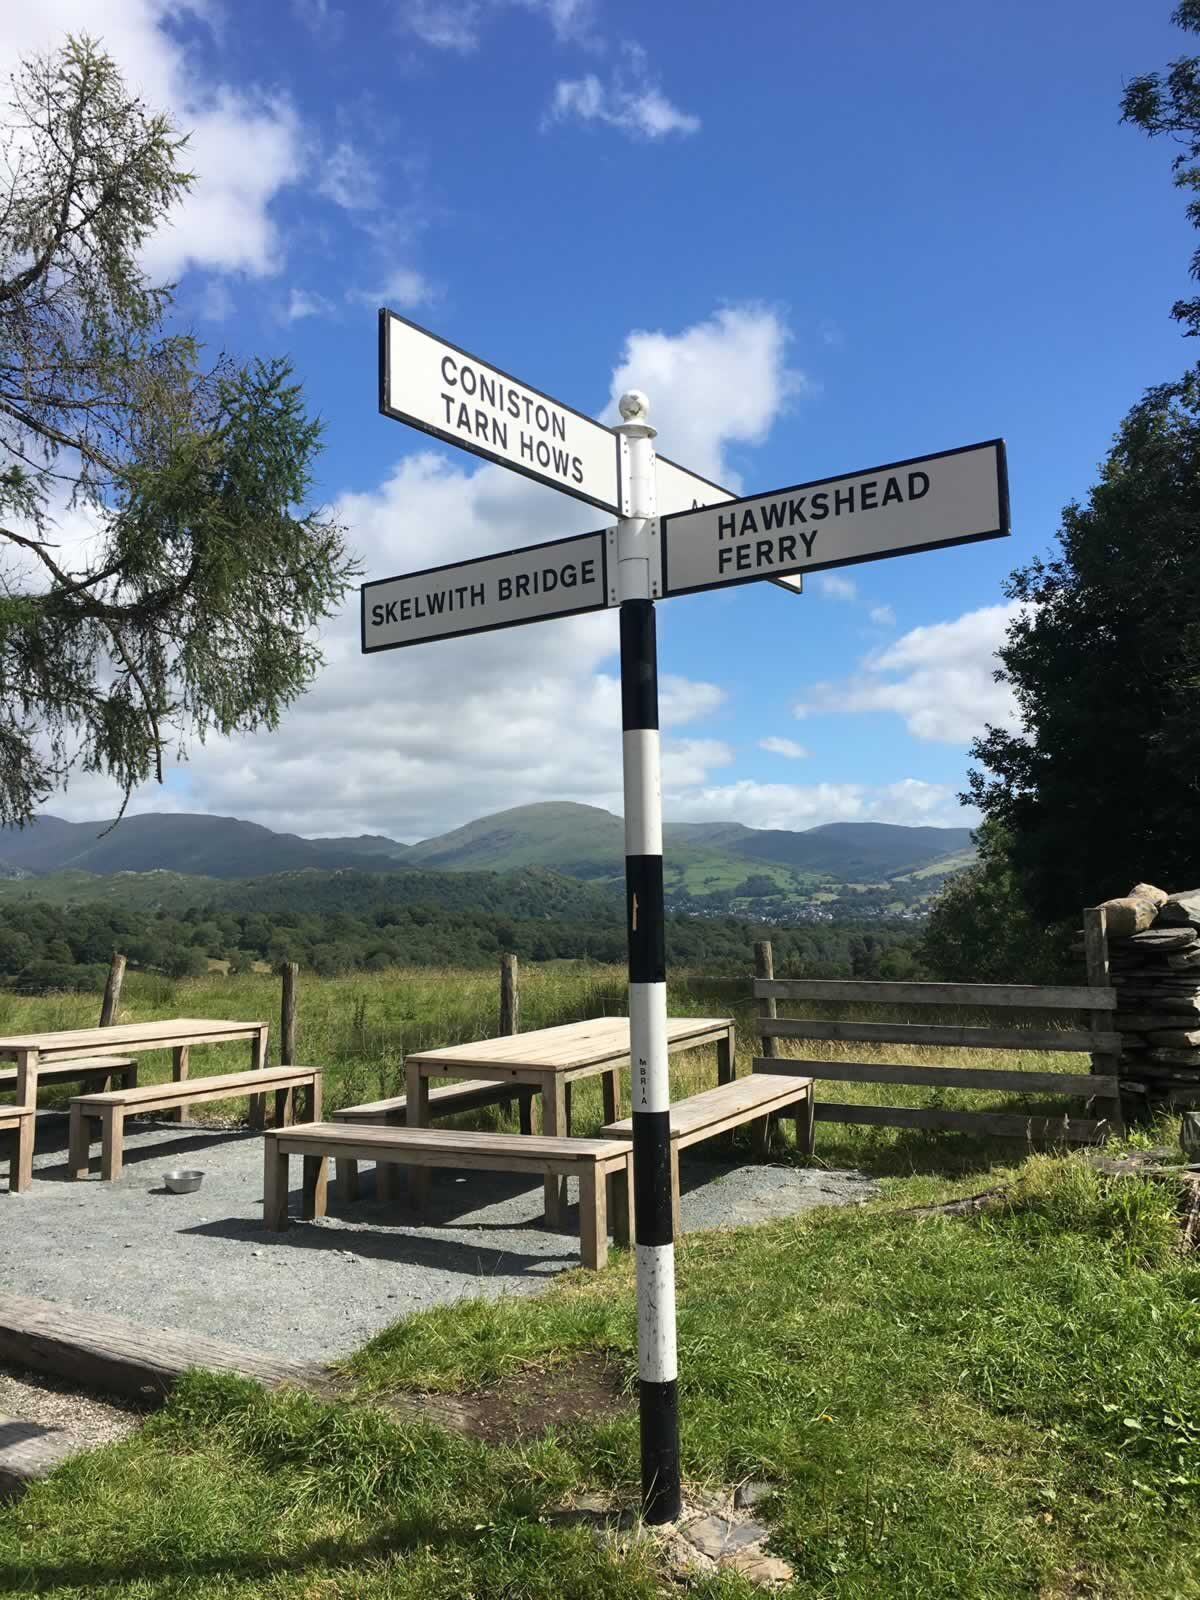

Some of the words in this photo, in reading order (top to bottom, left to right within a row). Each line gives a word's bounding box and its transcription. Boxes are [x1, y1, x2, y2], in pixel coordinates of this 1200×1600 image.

[441, 356, 566, 441] CONISTON
[441, 393, 508, 450] TARN
[520, 431, 584, 484] HOWS
[718, 471, 930, 540] HAWKSHEAD
[718, 530, 818, 574] FERRY
[371, 583, 485, 627] SKELWITH
[498, 559, 596, 600] BRIDGE
